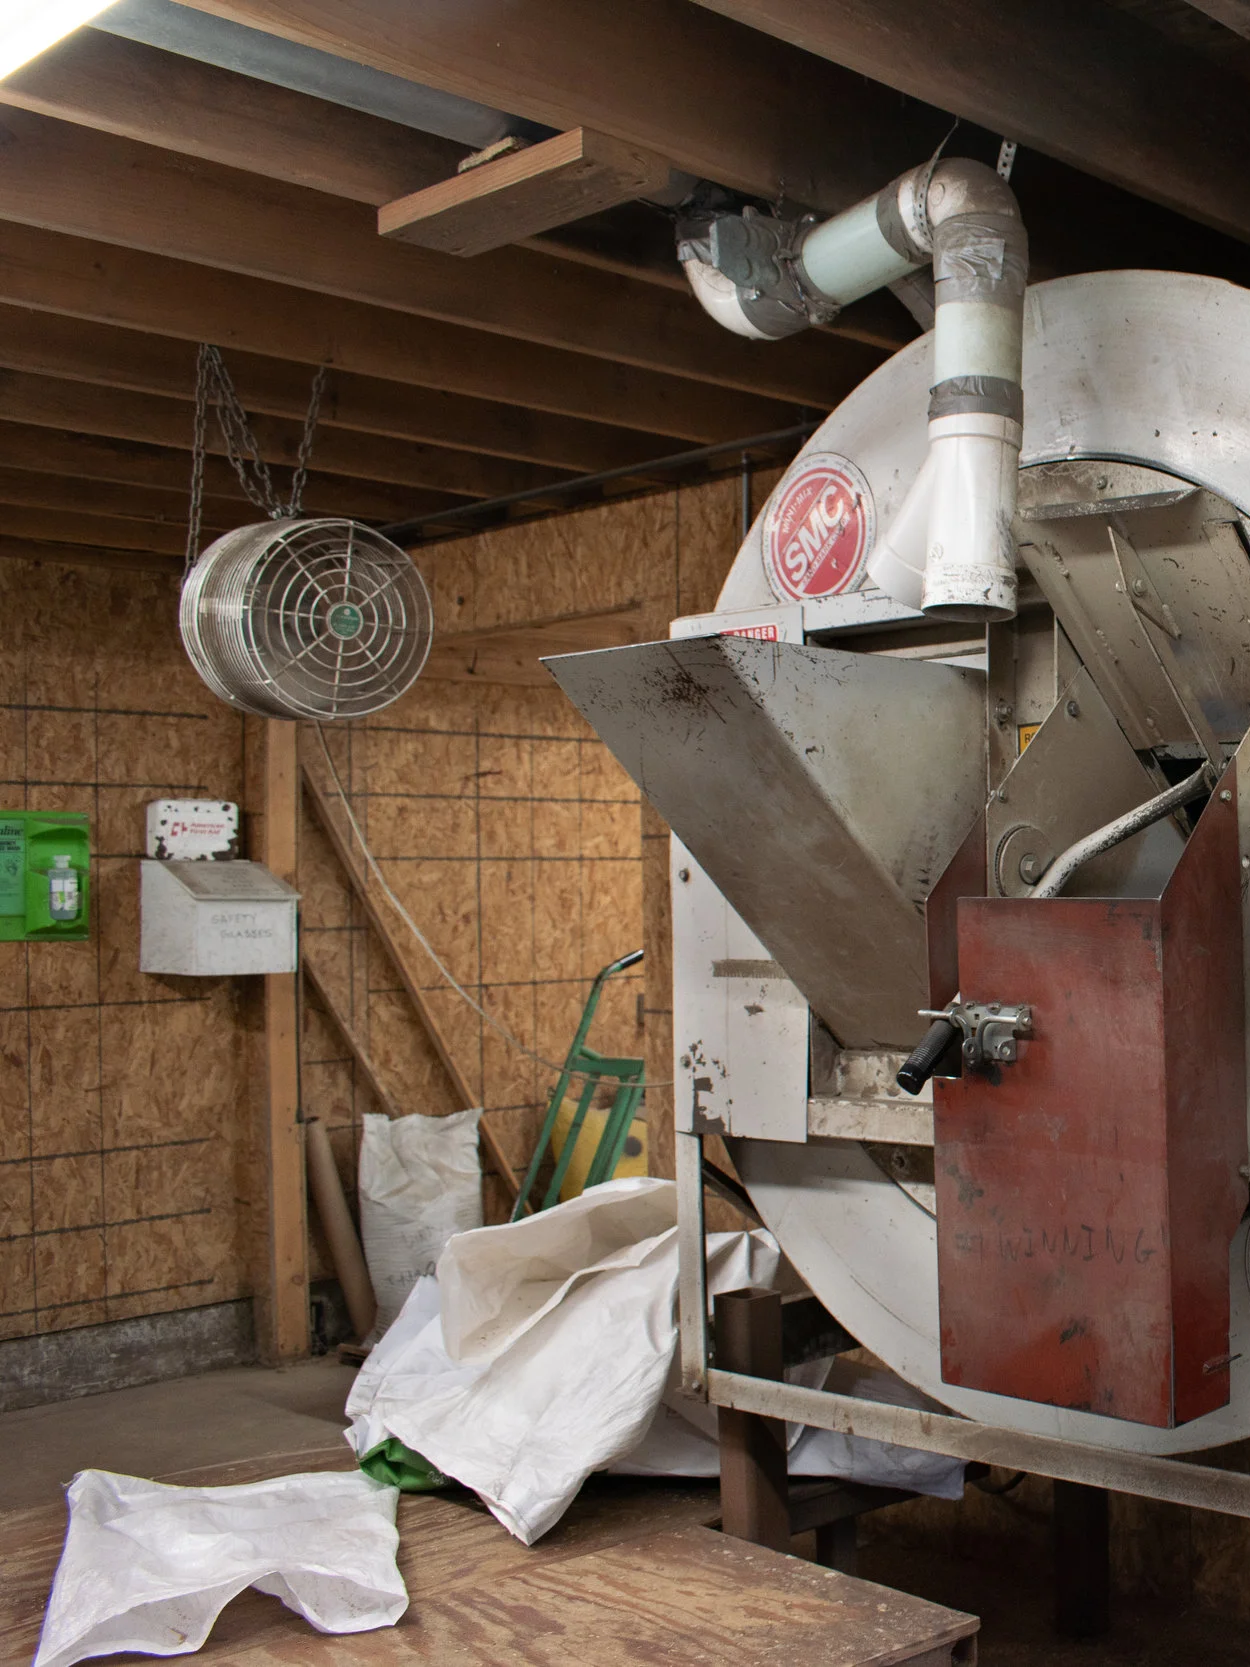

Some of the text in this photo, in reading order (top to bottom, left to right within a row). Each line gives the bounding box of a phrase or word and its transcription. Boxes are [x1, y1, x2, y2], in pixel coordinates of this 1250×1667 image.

[785, 485, 844, 582] SMC
[734, 626, 774, 639] DANGER
[211, 914, 258, 925] SAFETY
[220, 929, 273, 939] GLASSES
